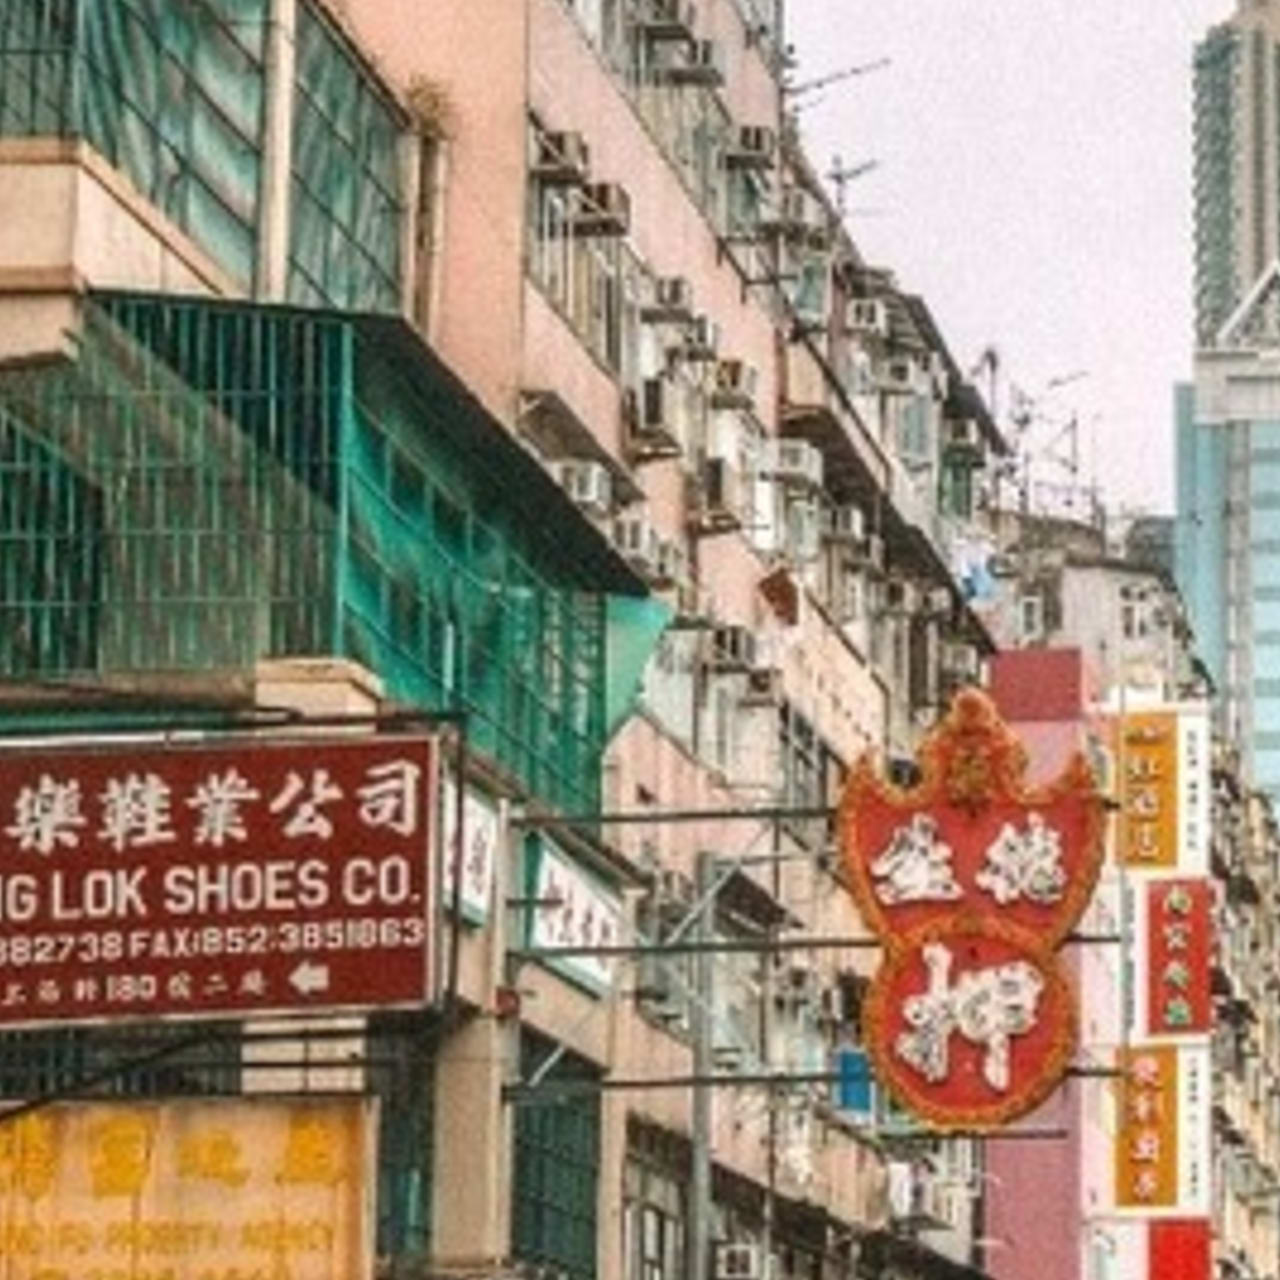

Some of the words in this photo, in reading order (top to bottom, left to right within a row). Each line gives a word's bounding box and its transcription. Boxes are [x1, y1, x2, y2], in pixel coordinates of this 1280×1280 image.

[51, 867, 148, 921] LOK
[163, 859, 329, 915] SHOES
[341, 854, 422, 908] CO.
